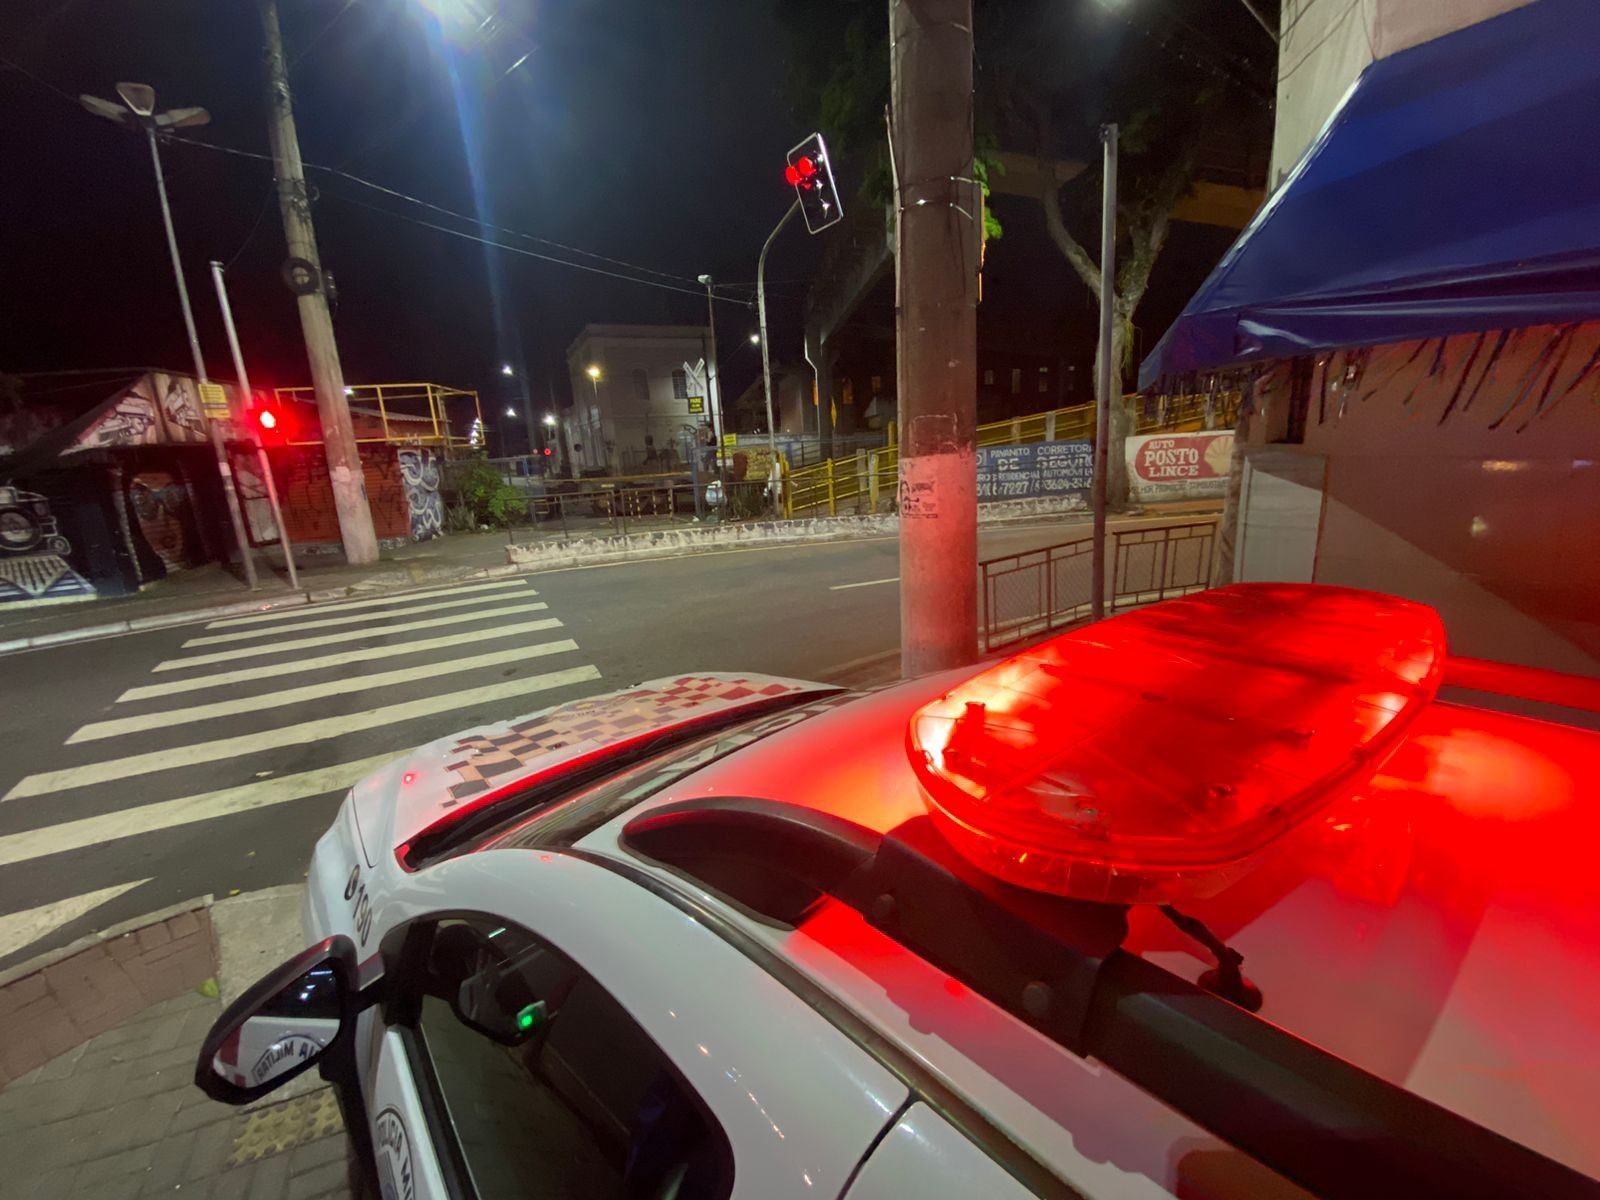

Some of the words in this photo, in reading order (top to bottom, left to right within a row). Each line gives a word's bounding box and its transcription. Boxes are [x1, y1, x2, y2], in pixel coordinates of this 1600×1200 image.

[1148, 440, 1175, 450] AUTO
[1144, 448, 1199, 467] POSTO
[997, 458, 1020, 471] DE
[1148, 465, 1199, 477] LINCE
